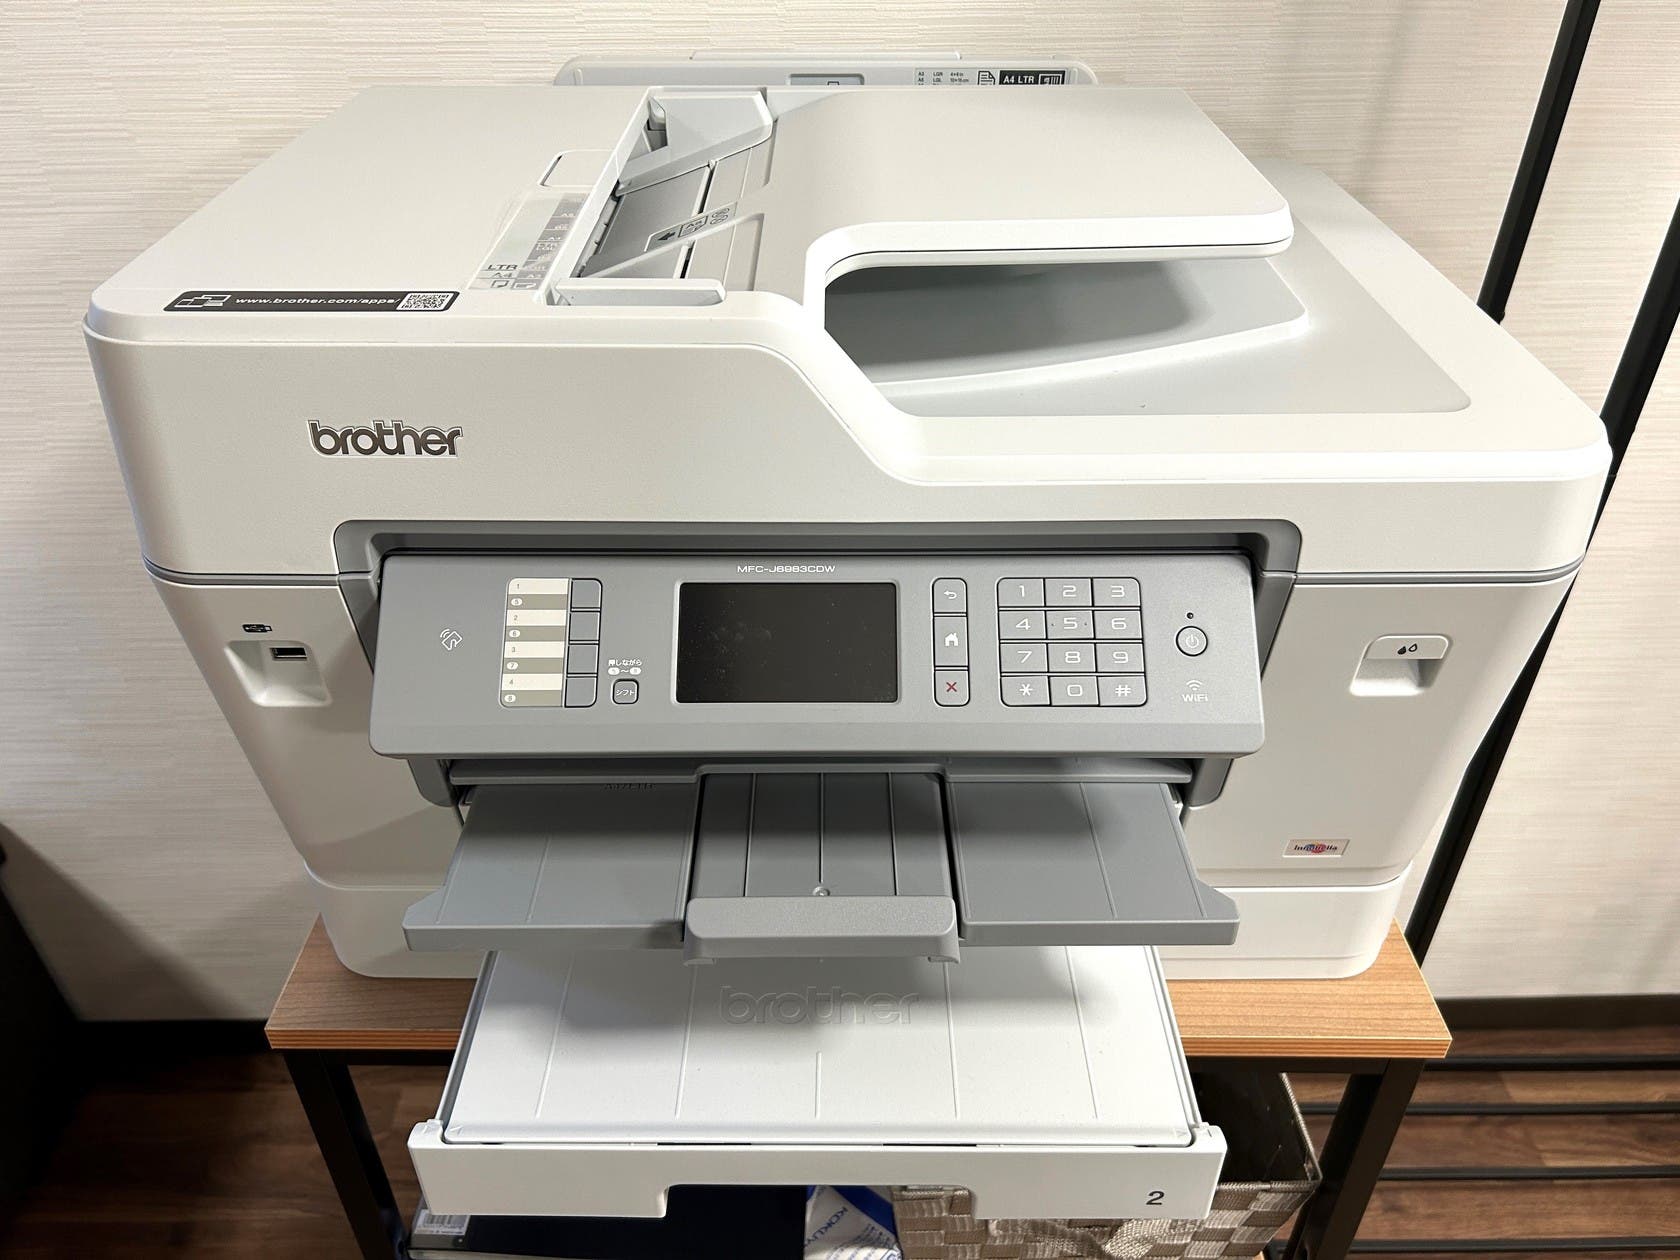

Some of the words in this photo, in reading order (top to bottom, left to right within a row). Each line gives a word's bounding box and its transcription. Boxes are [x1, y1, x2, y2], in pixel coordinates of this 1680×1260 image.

[1003, 75, 1015, 83] A4
[1018, 75, 1034, 83] LTR
[308, 421, 463, 457] brother
[1019, 585, 1025, 597] 1
[1063, 585, 1077, 597] 2
[1111, 585, 1125, 597] 3
[1016, 618, 1031, 630] 4
[1063, 618, 1078, 630] 5
[1112, 618, 1126, 630] 6
[1017, 651, 1032, 663] 7
[1065, 651, 1081, 663] 8
[1113, 651, 1128, 663] 9
[1067, 684, 1083, 696] 0
[1115, 684, 1131, 696] #
[1181, 693, 1208, 702] WiFi
[719, 986, 919, 1024] brother
[1145, 1190, 1165, 1206] 2
